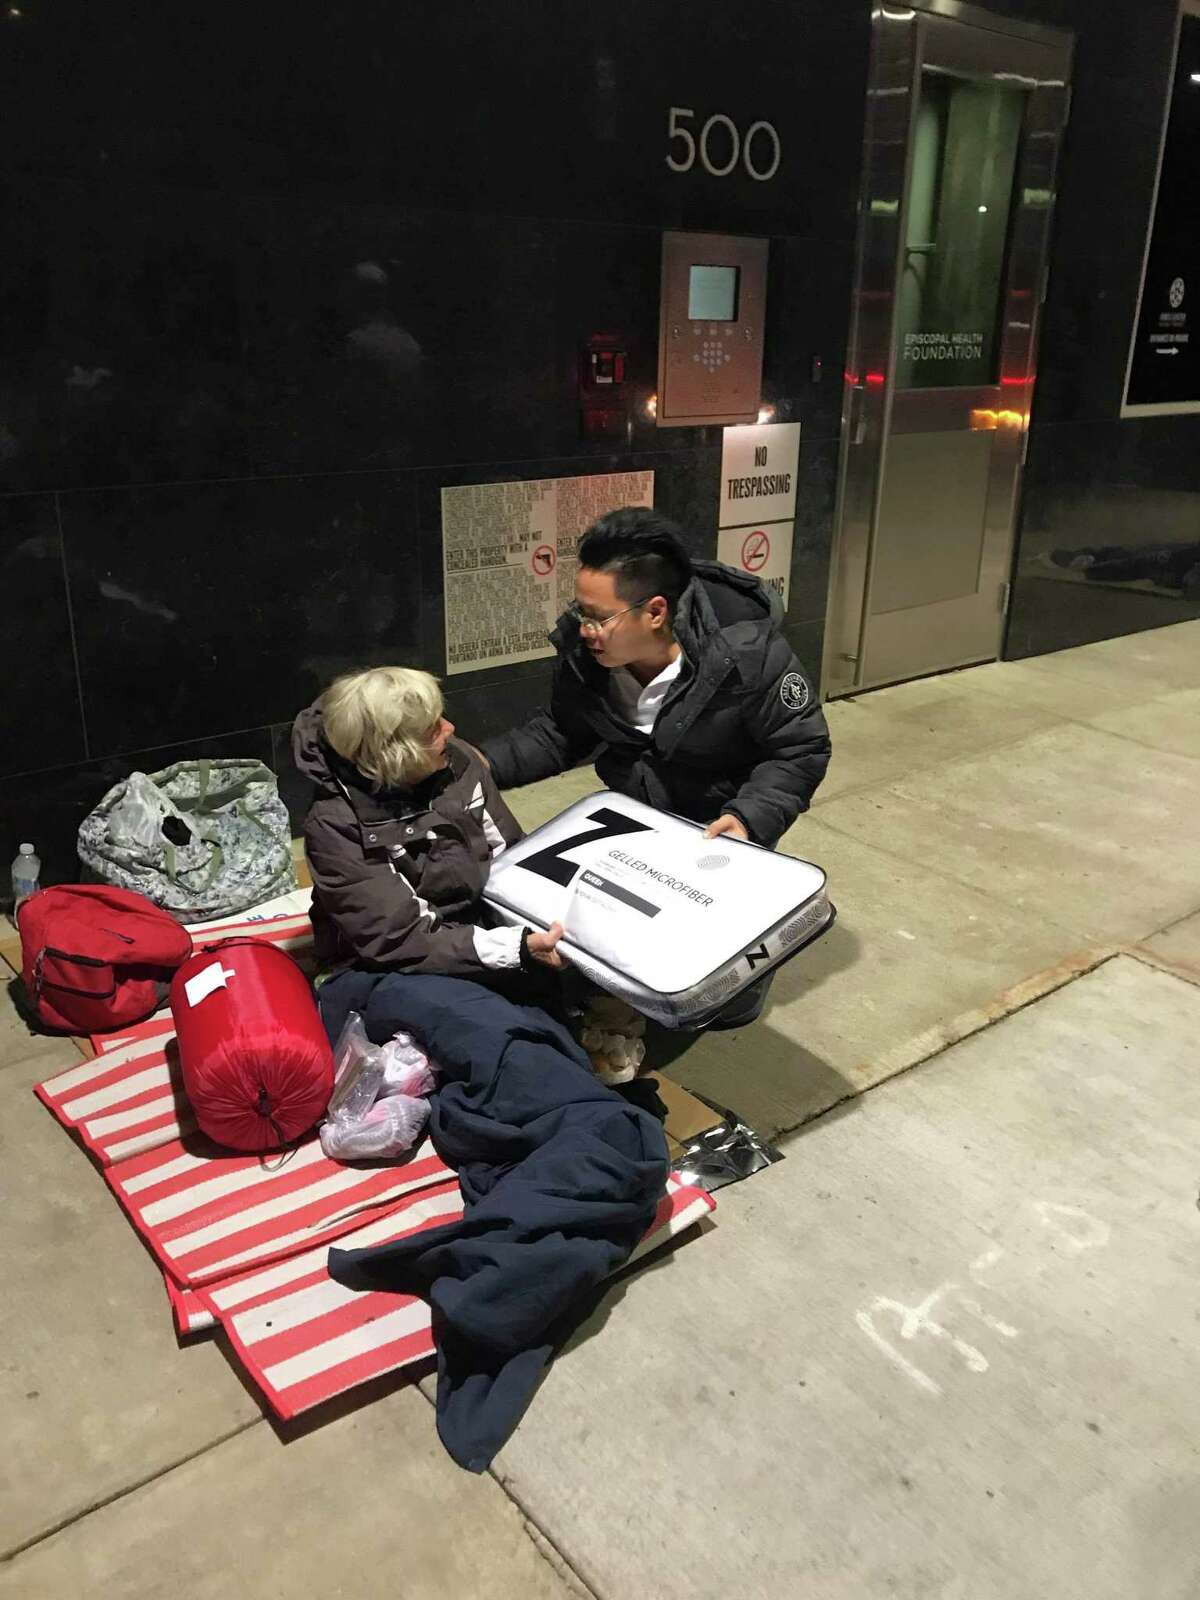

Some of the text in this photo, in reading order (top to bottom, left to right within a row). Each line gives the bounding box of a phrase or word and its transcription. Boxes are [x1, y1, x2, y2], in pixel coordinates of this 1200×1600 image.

[666, 107, 780, 181] 500
[904, 332, 984, 345] EPISCOPAL HEALTH
[903, 345, 982, 361] FOUNDATION
[754, 445, 768, 468] NO
[727, 473, 791, 501] TRESPASSING
[608, 850, 648, 871] GELLED
[644, 867, 714, 908] MICROFIBER
